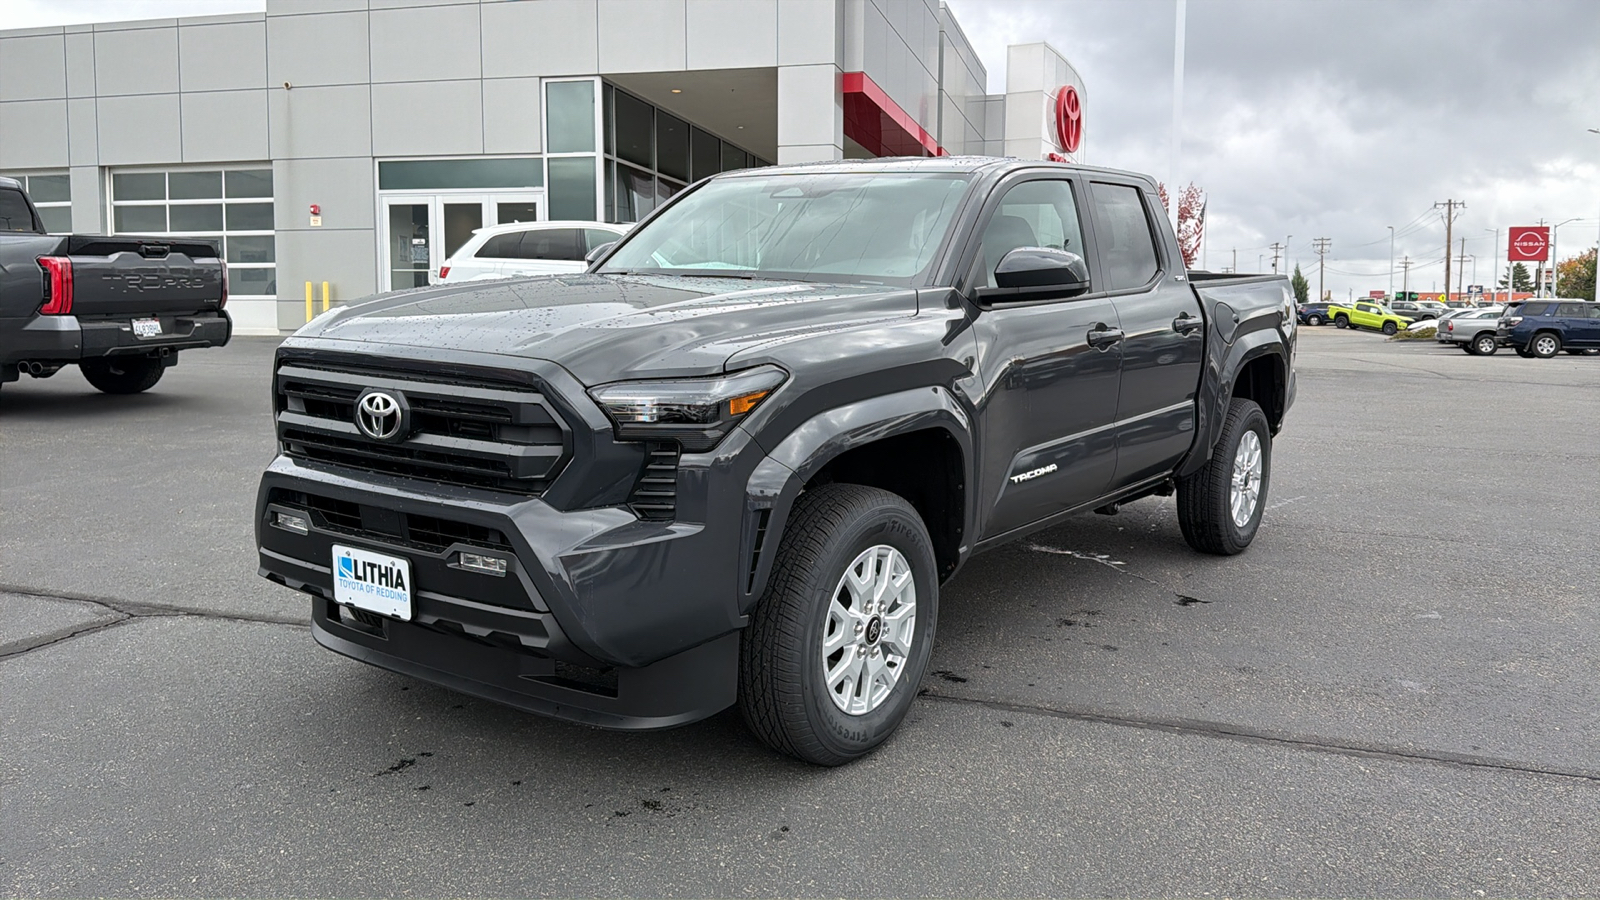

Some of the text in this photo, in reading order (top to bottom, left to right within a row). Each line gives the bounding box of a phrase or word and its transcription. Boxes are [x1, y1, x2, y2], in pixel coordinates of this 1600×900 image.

[102, 273, 204, 293] TRD PRO
[1010, 463, 1058, 484] TACOMA
[353, 558, 407, 592] LITHIA
[339, 578, 408, 603] TOYOTA OF REDDING
